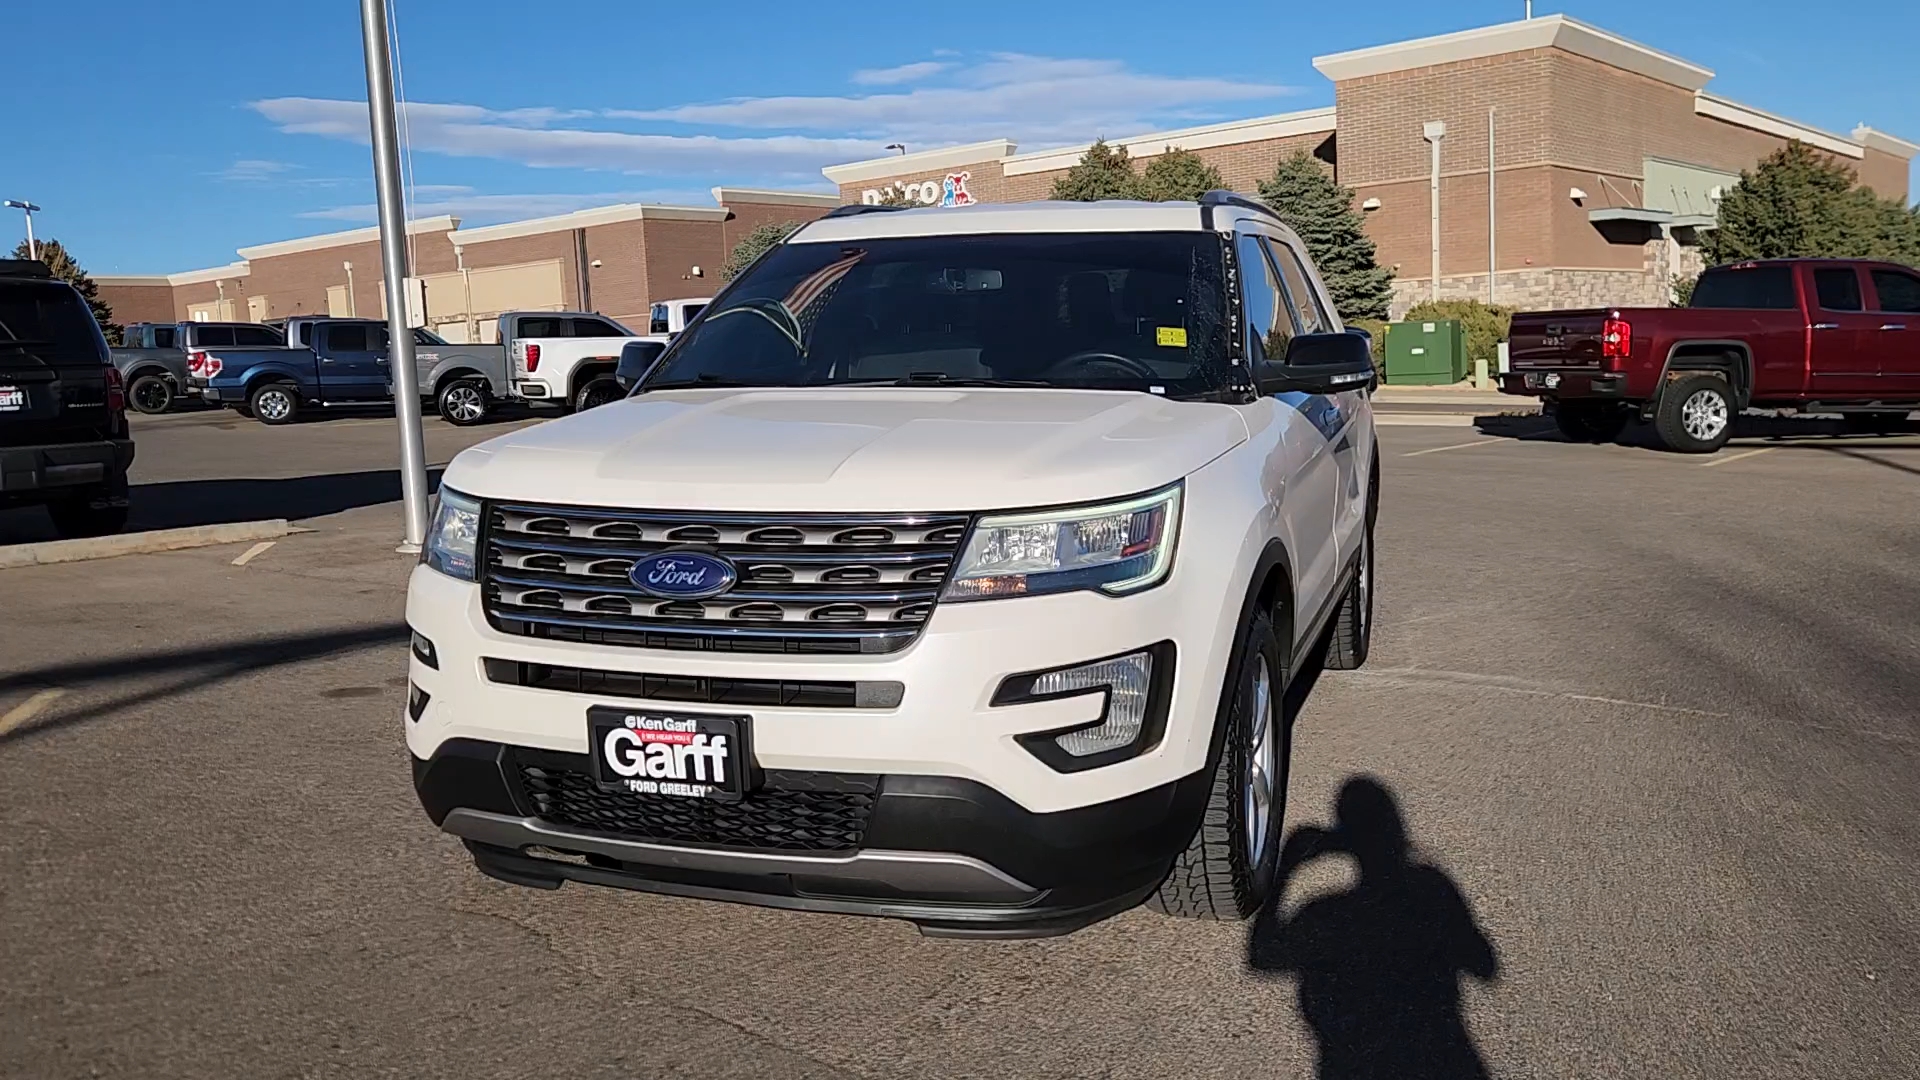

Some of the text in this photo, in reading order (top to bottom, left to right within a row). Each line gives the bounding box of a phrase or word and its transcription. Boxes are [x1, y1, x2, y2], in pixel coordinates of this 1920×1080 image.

[862, 180, 940, 205] pco
[0, 391, 23, 405] arff
[648, 559, 707, 585] Ford
[663, 717, 696, 733] Garff
[604, 727, 728, 783] Garff
[629, 779, 706, 798] FORD GREELEY
